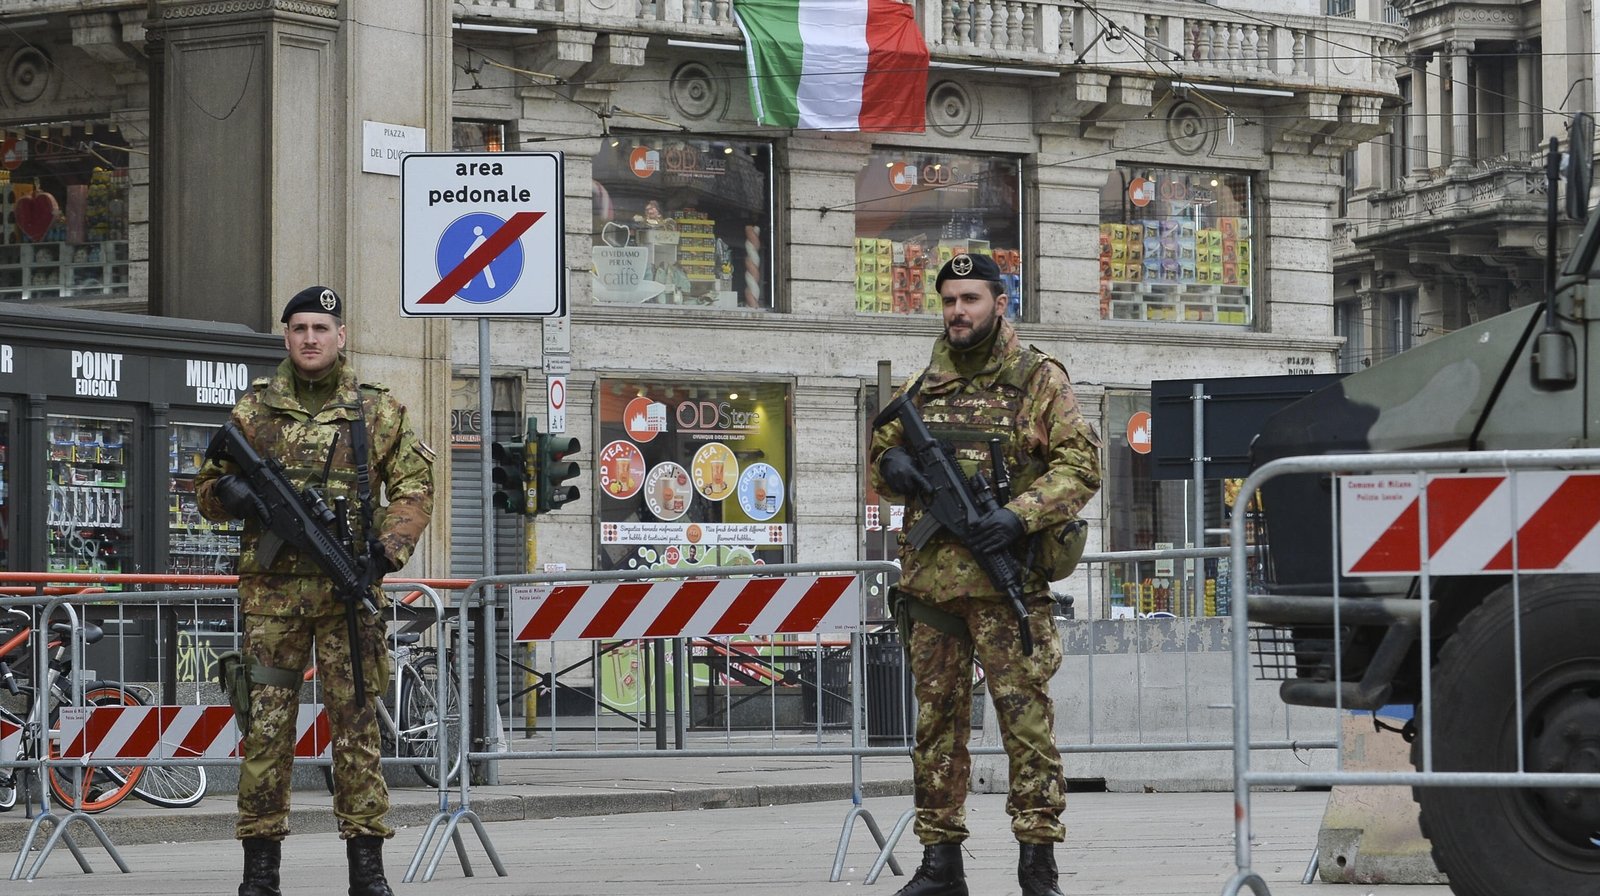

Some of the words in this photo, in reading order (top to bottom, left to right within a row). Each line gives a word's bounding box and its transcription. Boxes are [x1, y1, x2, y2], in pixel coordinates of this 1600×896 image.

[384, 128, 406, 139] PIAZZA
[370, 148, 383, 158] DEL
[455, 162, 504, 176] area
[429, 185, 531, 206] pedonale
[604, 267, 639, 286] caffè
[1, 344, 13, 373] R
[71, 350, 124, 382] POINT
[1287, 357, 1314, 366] PIAZZA
[186, 359, 248, 391] MILANO
[75, 378, 118, 397] EDICOLA
[196, 387, 236, 405] EDICOLA
[676, 401, 760, 429] ODStore
[602, 443, 624, 463] TEA
[698, 446, 718, 464] TEA
[600, 465, 610, 486] OD
[648, 464, 674, 495] CREAM
[694, 467, 704, 488] OD
[740, 465, 767, 492] CREAM
[650, 499, 662, 515] OD
